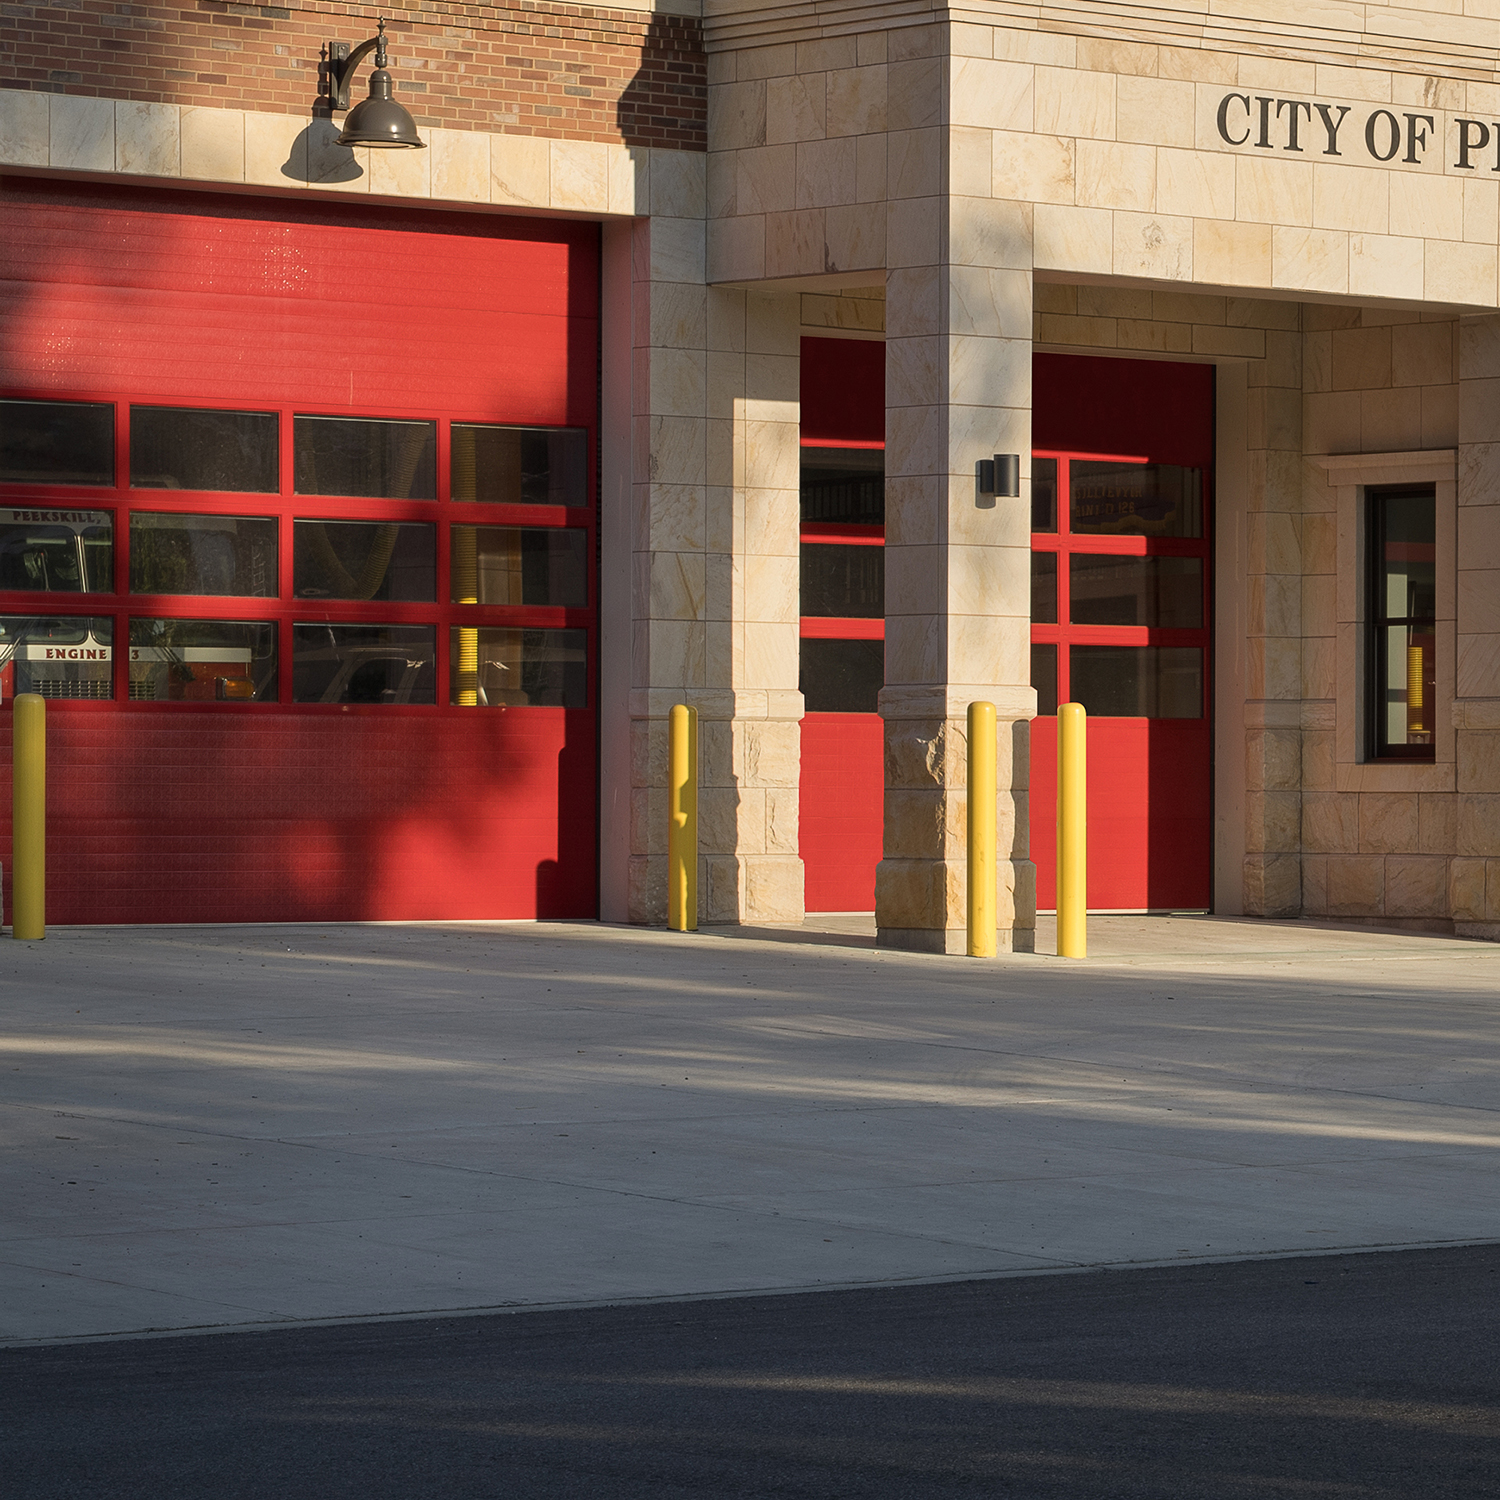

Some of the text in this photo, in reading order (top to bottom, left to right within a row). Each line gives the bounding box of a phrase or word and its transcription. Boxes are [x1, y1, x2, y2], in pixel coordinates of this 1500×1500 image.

[1216, 92, 1352, 156] CITY
[1364, 109, 1435, 164] OF
[45, 648, 140, 660] ENGINE 3
